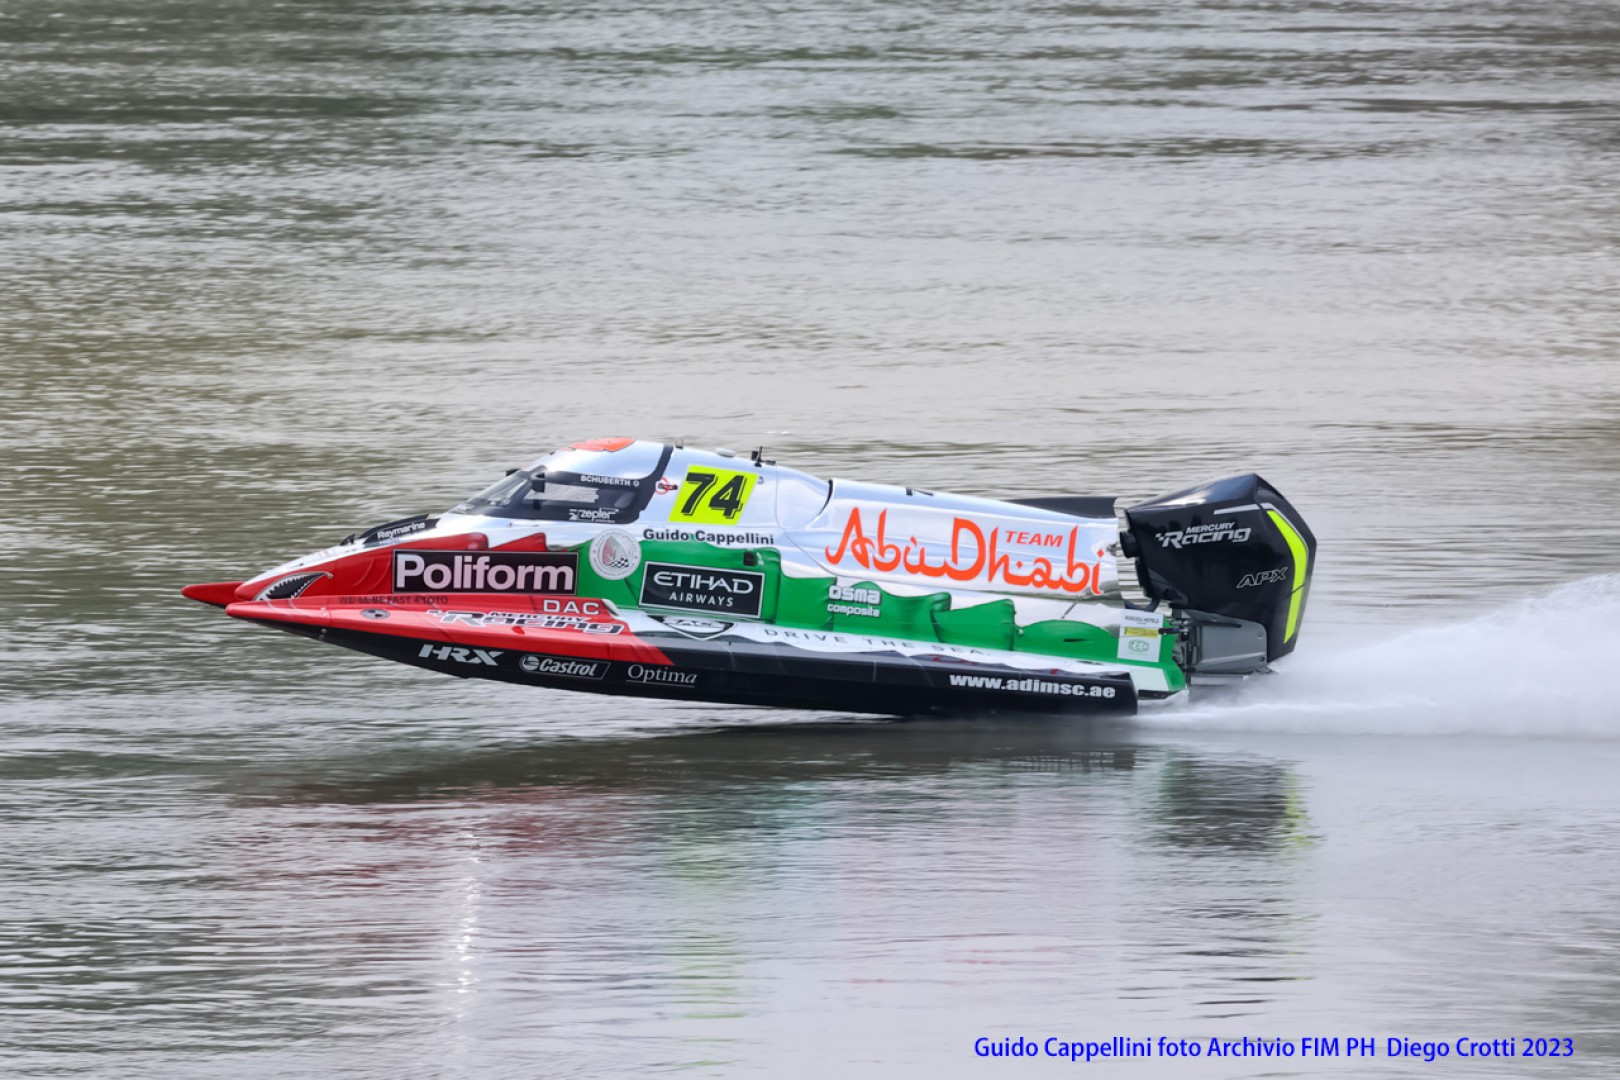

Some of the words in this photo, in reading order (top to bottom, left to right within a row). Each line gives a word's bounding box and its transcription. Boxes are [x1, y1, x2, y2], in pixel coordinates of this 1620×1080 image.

[580, 475, 631, 487] SCHUBERTH
[681, 472, 747, 519] 74
[376, 522, 426, 540] Raymarine
[643, 528, 689, 542] Guido
[695, 530, 774, 546] Cappellini
[1186, 521, 1236, 533] MERCURY
[1005, 530, 1063, 548] TEAM
[1160, 528, 1252, 549] Racing
[949, 517, 1104, 596] Dhabi
[396, 554, 574, 591] Poliform
[653, 571, 754, 595] ETIHAD
[1236, 567, 1288, 589] APX
[543, 599, 600, 615] DAC
[669, 591, 734, 608] AIRWAYS
[827, 604, 881, 618] composite
[440, 610, 625, 635] Racing
[764, 628, 848, 644] DRIVE
[863, 638, 916, 649] THE
[418, 643, 504, 667] HRX
[538, 656, 599, 677] Castrol
[627, 663, 698, 685] Optima
[949, 674, 1116, 699] www.adimsc.ae
